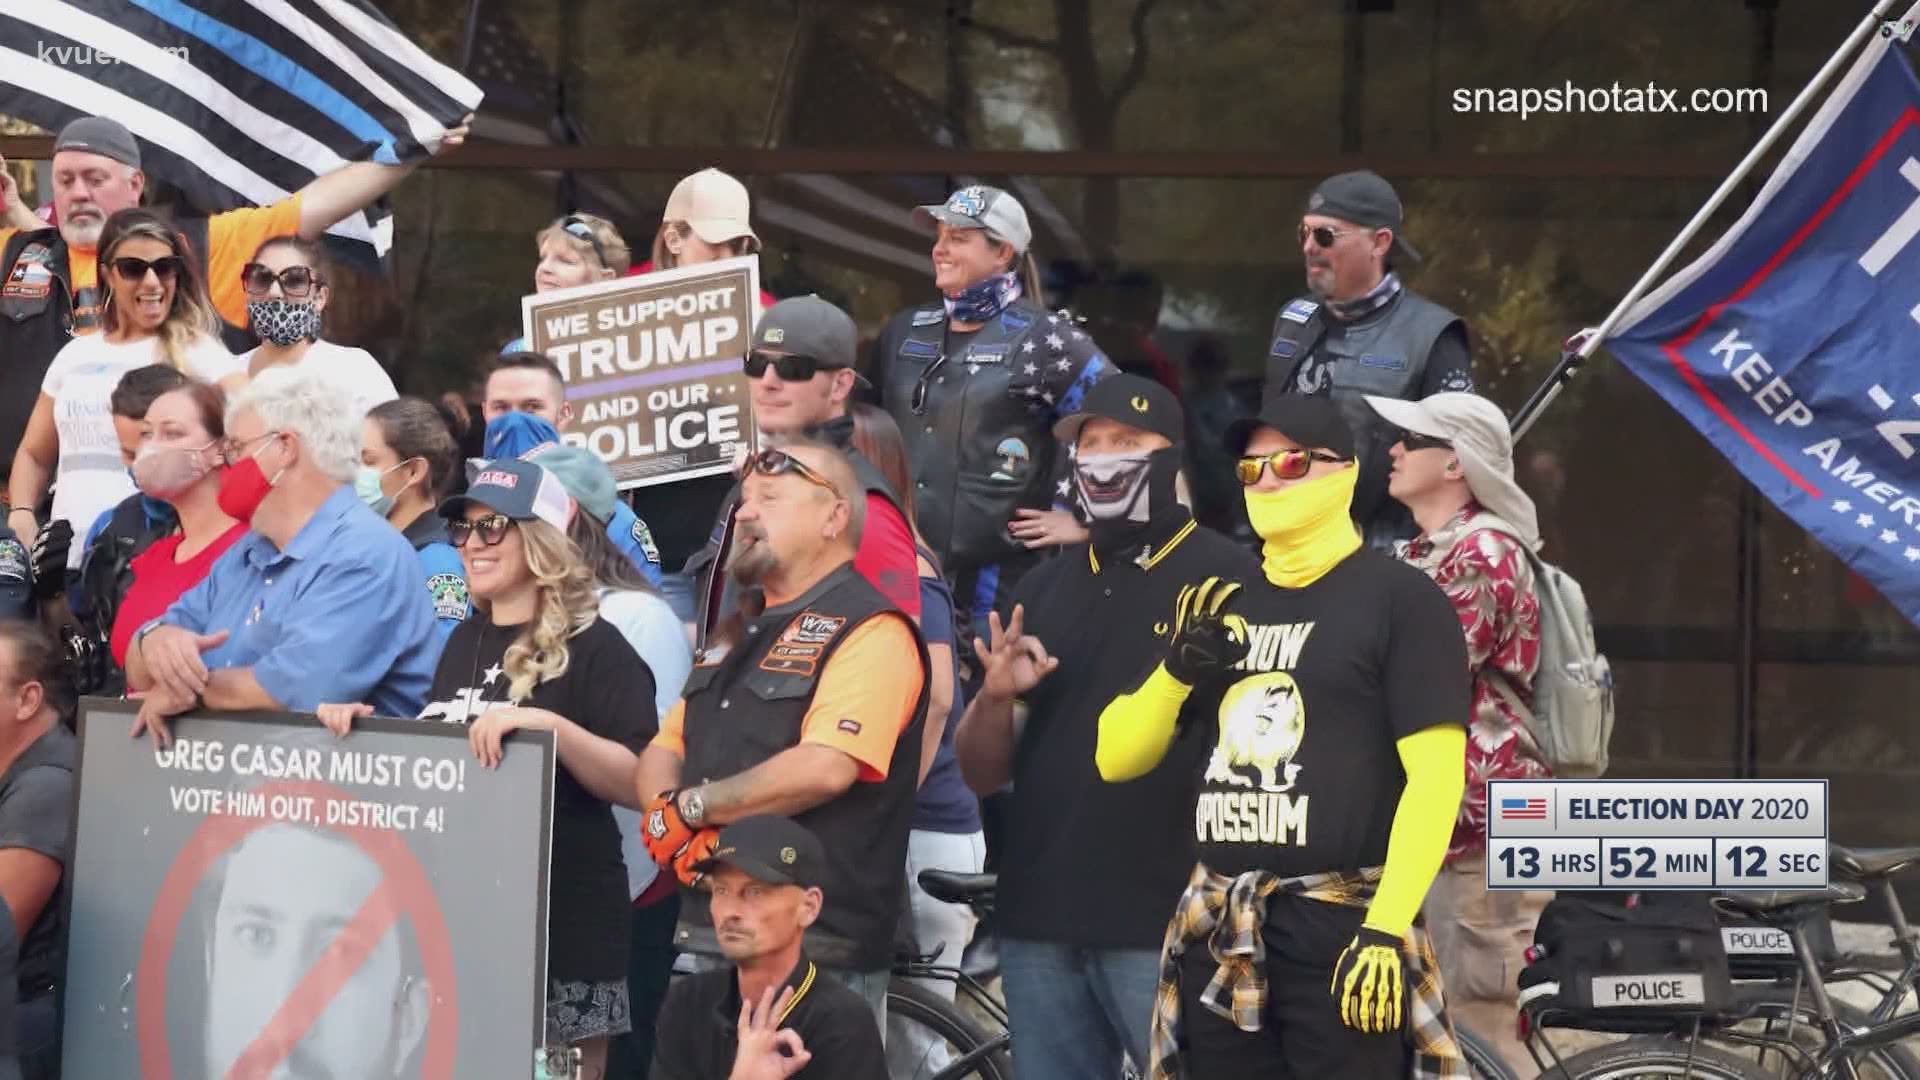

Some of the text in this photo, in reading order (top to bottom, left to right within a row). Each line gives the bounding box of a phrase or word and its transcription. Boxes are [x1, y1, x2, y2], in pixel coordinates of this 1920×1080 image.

[546, 288, 736, 341] WE SUPPORT
[547, 316, 739, 382] TRUMP
[581, 384, 709, 425] AND OUR
[1709, 328, 1813, 427] KEEP
[1802, 438, 1920, 532] AMER
[1233, 621, 1316, 671] NOW
[155, 739, 466, 793] GREG CASAR MUST GO!
[169, 786, 445, 834] VOTE HIM OUT, DISTRICT 4!
[1729, 932, 1787, 949] POLICE
[1614, 980, 1684, 1002] POLICE
